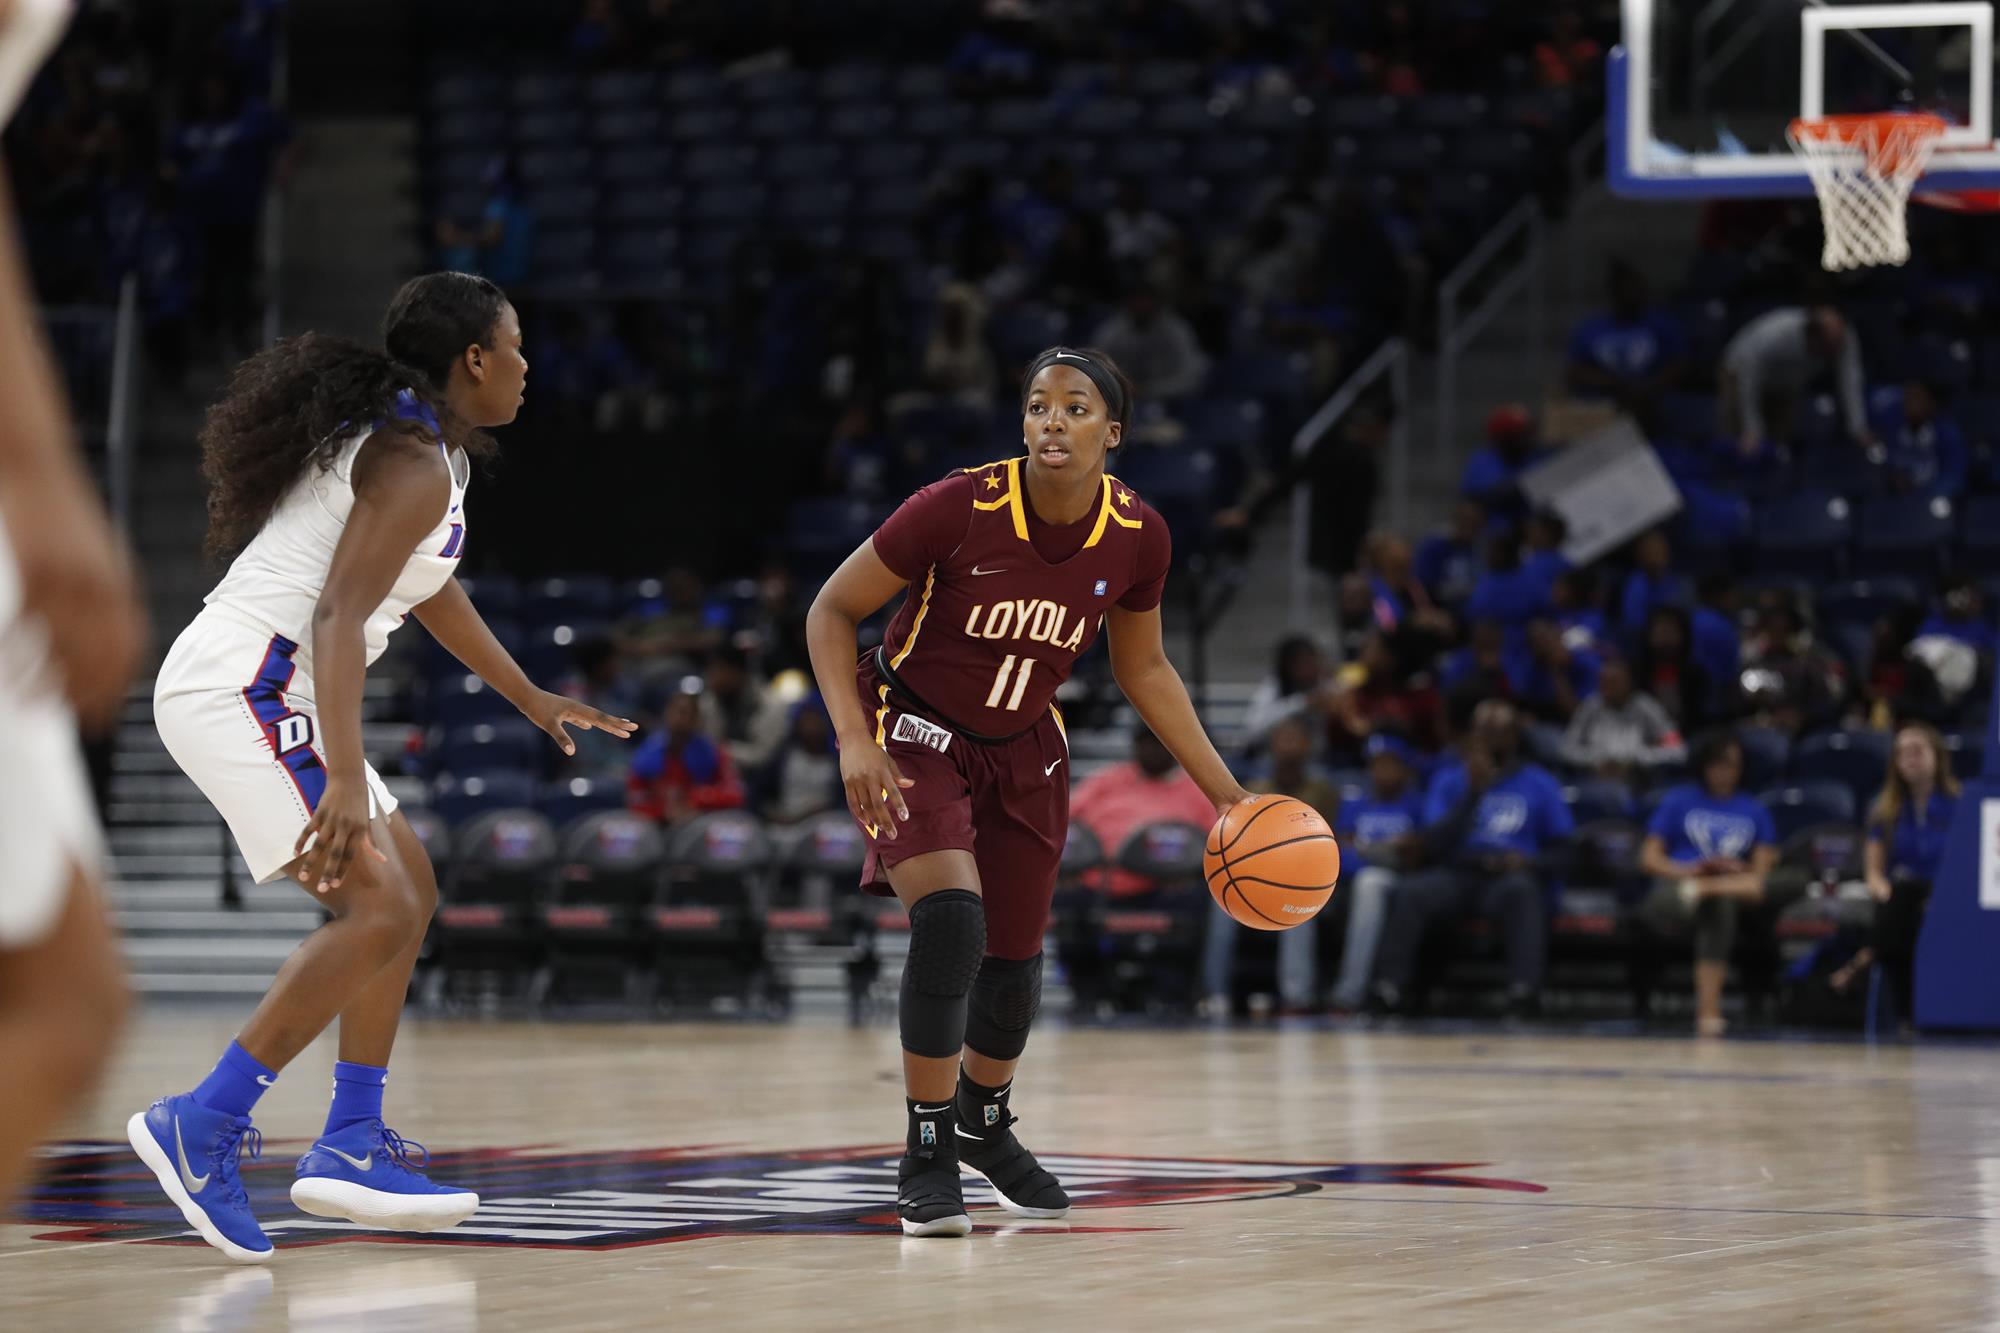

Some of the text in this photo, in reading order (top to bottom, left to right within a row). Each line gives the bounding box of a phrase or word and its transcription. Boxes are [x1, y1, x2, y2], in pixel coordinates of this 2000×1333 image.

[964, 598, 1086, 653] LOYOLA
[984, 653, 1038, 711] 11
[897, 715, 949, 750] VALLEY
